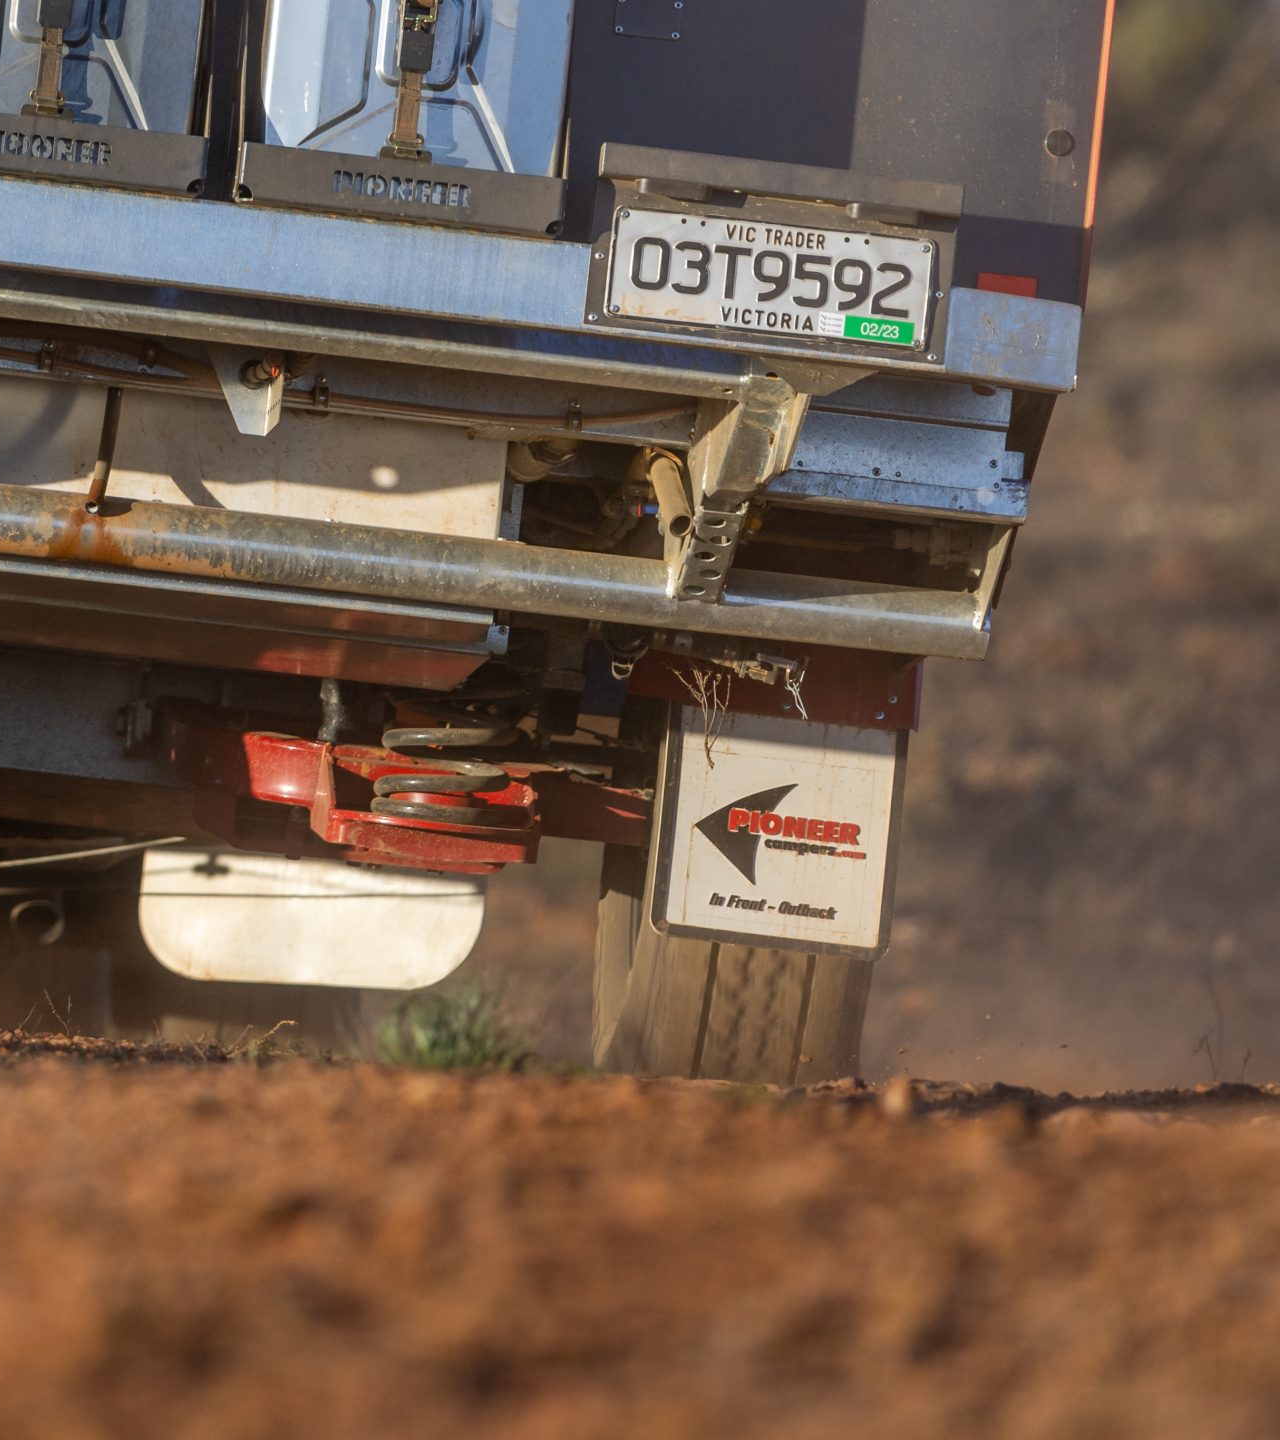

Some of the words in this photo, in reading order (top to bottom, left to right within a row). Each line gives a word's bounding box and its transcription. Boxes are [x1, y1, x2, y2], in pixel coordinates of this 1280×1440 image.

[726, 223, 756, 244] VIC
[765, 228, 826, 250] TRADER
[630, 236, 913, 318] 03T9592
[720, 306, 813, 332] VICTORIA
[860, 322, 899, 339] 02/23
[727, 807, 861, 846] PIONEER
[709, 892, 725, 907] In
[726, 894, 767, 911] Front
[778, 901, 838, 920] Outback
